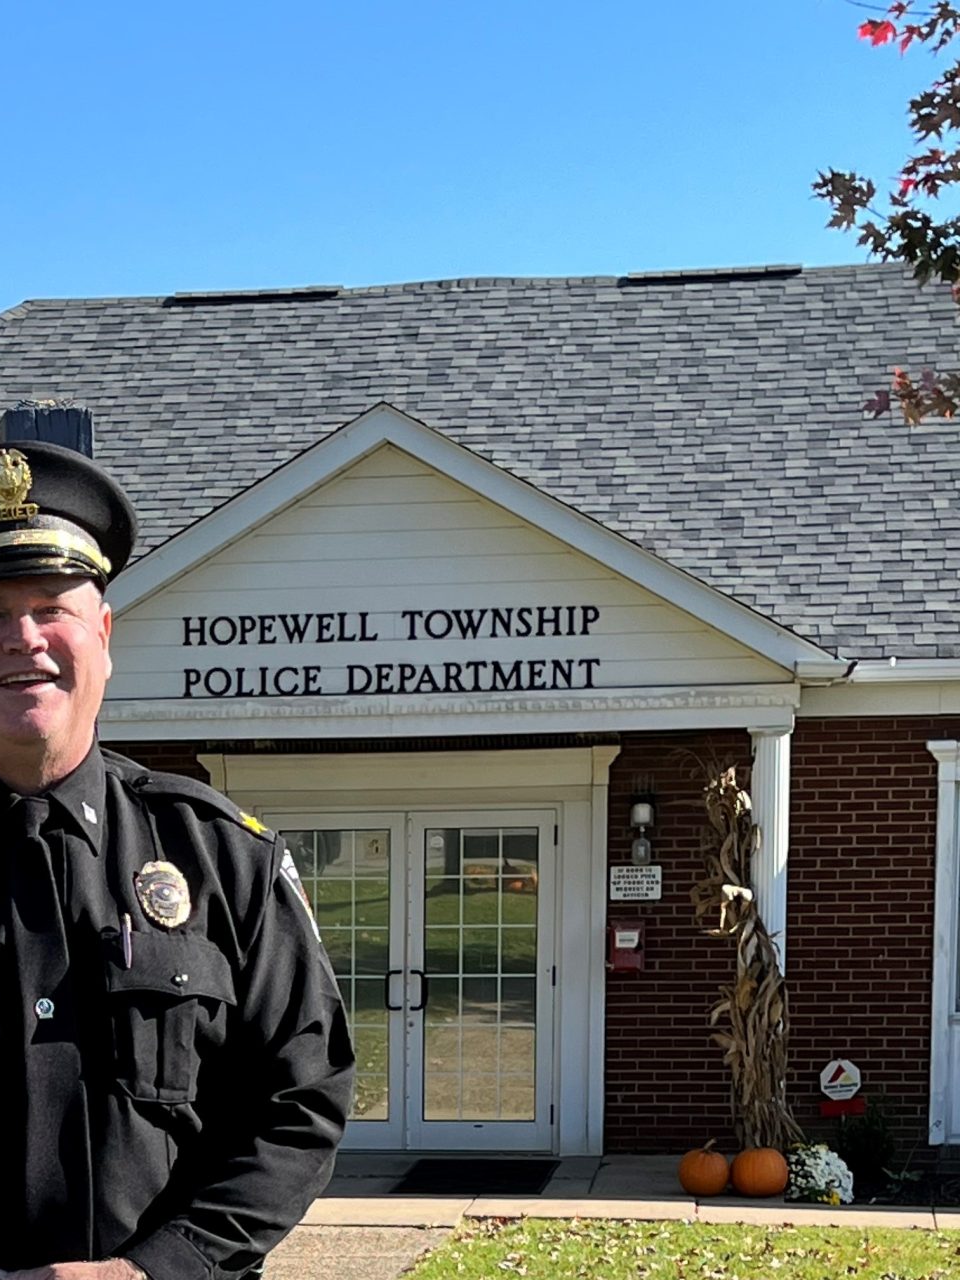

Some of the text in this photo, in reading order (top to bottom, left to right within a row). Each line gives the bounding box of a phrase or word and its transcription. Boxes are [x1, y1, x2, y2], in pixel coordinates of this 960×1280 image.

[182, 606, 600, 646] HOPEWELL TOWNSHIP
[183, 659, 600, 697] POLICE DEPARTMENT
